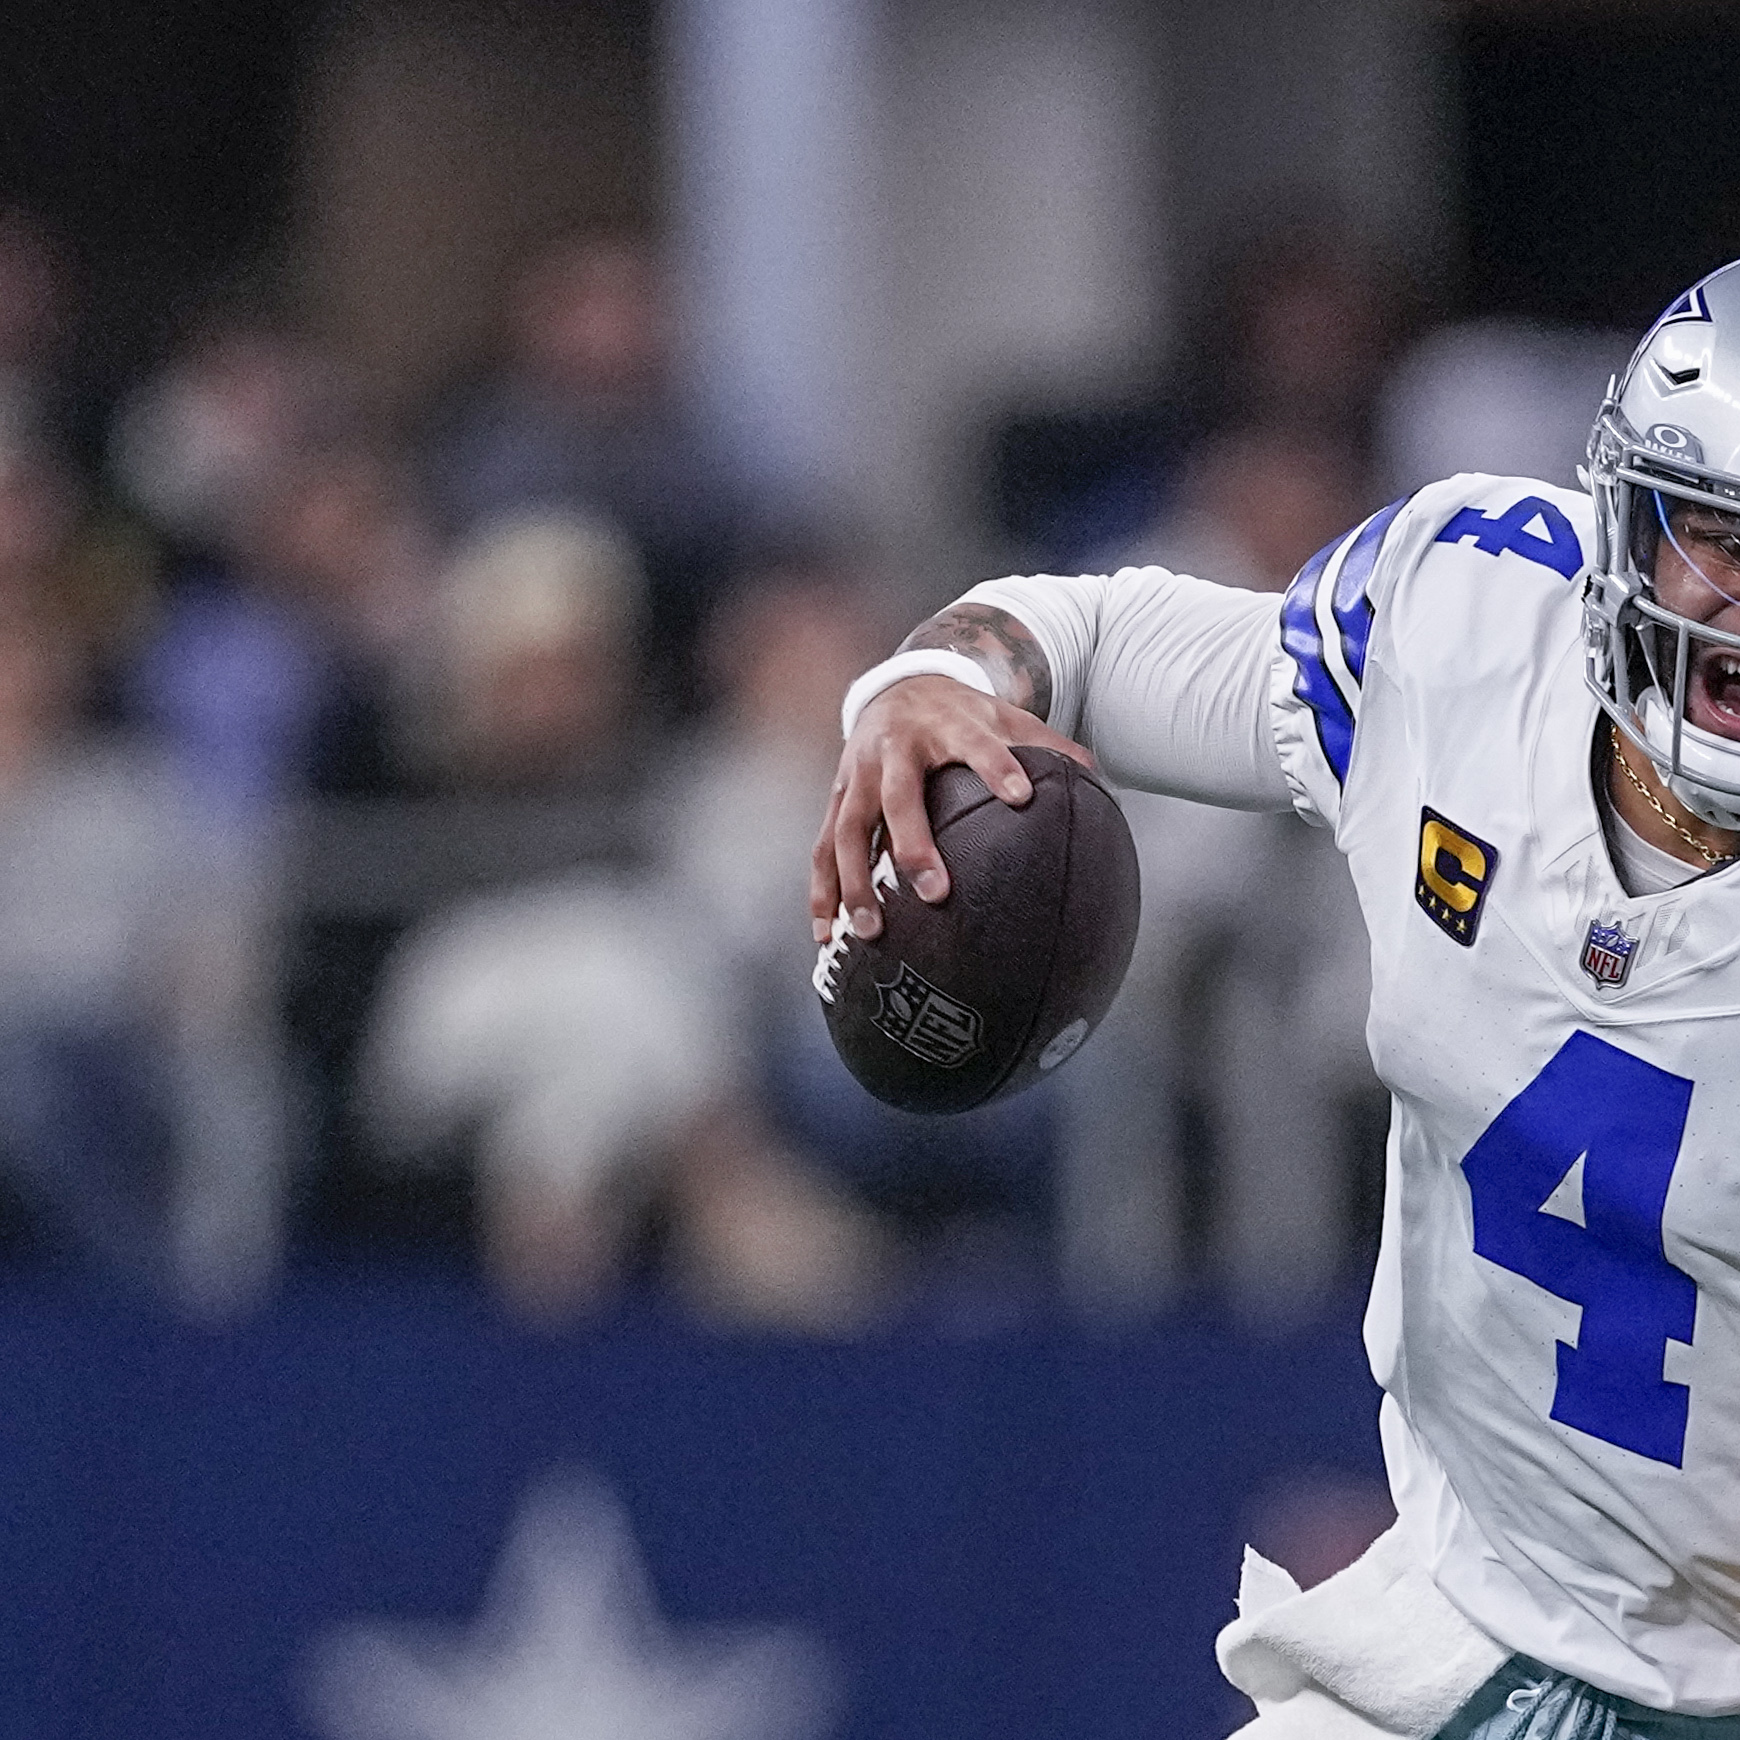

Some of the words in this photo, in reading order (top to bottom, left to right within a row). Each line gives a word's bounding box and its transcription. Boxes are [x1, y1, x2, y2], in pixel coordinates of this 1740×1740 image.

[1433, 495, 1585, 583] 4
[1421, 819, 1487, 913] C
[1586, 945, 1622, 981] NFL
[909, 1001, 975, 1063] NFL
[1459, 1028, 1699, 1471] 4
